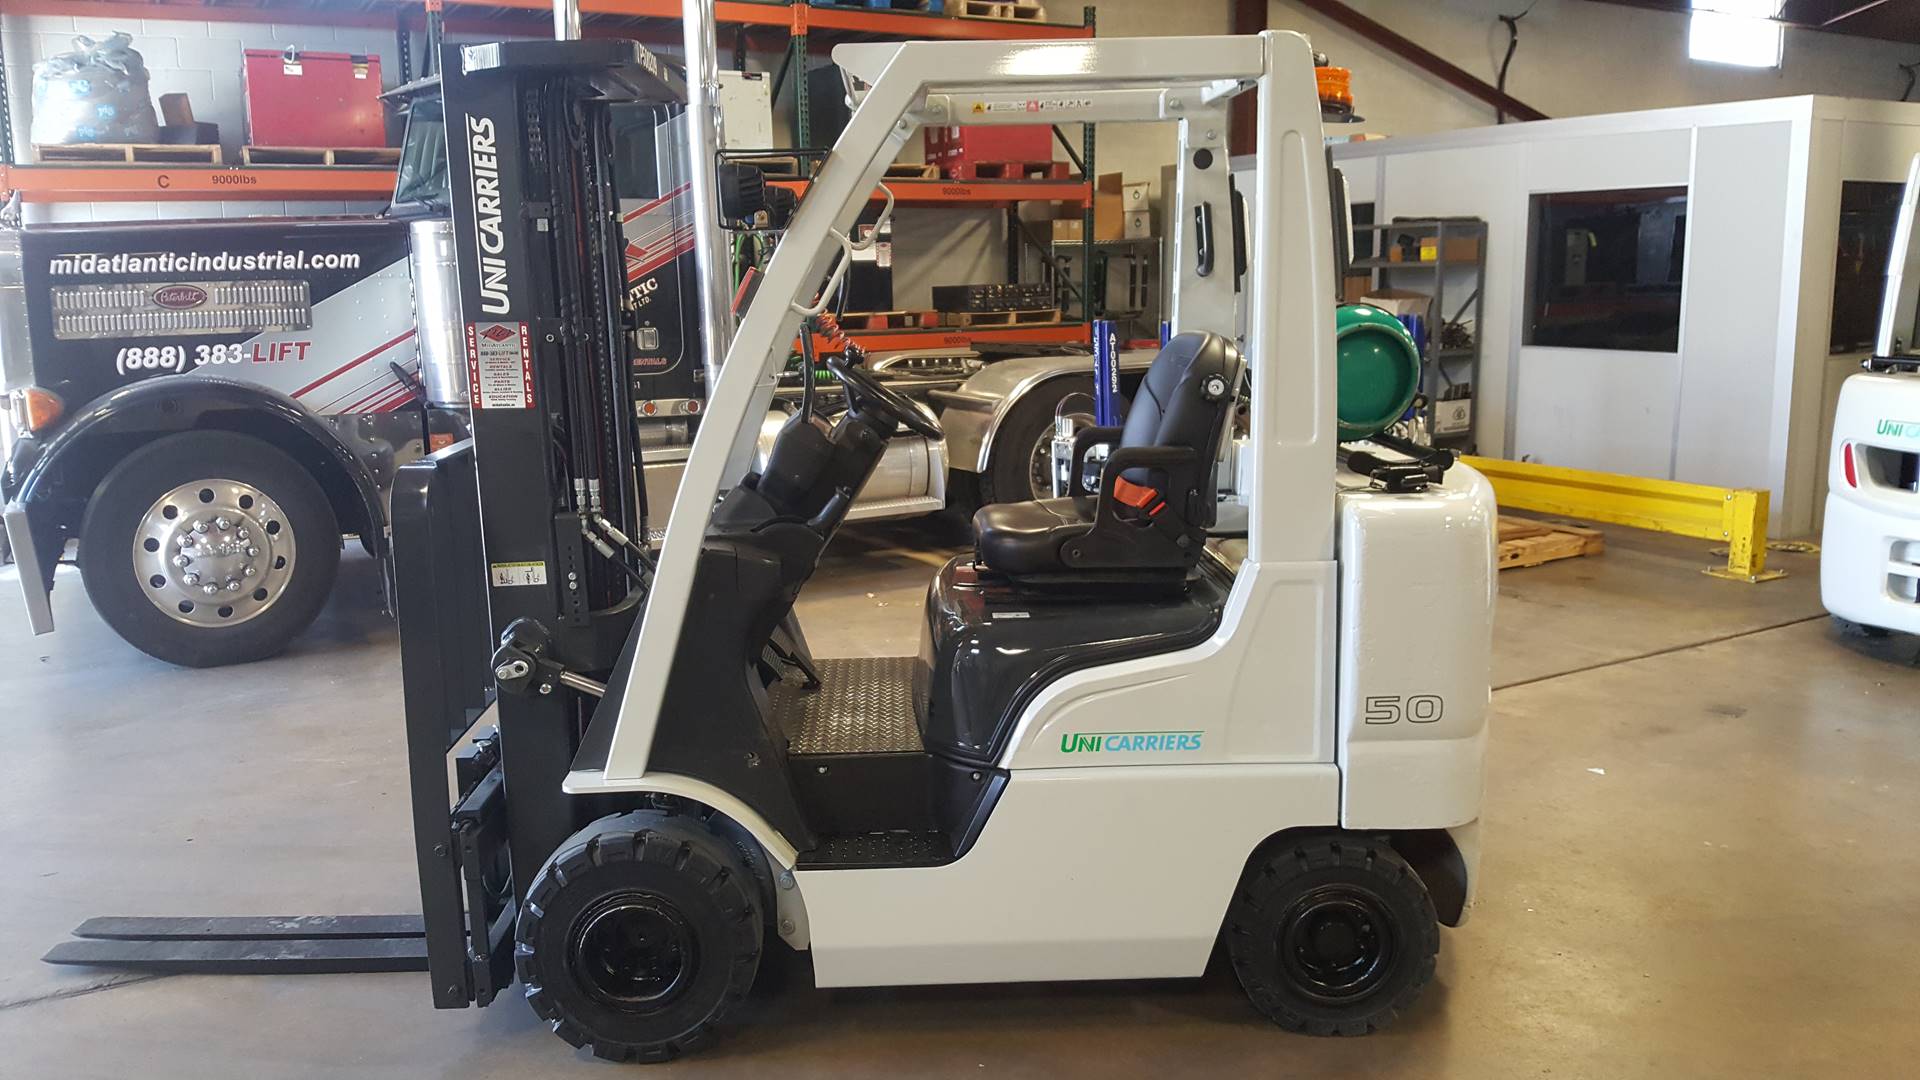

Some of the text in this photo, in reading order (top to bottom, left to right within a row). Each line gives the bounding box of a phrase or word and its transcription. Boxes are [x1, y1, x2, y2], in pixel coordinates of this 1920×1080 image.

[157, 175, 170, 188] C
[211, 175, 257, 185] 9000lbs
[50, 250, 361, 274] midatlanticindustrial.com
[116, 341, 312, 375] (888) 383-LIFT
[468, 326, 480, 404] SERVICE
[521, 325, 533, 403] RENTALS
[1365, 695, 1443, 724] 50
